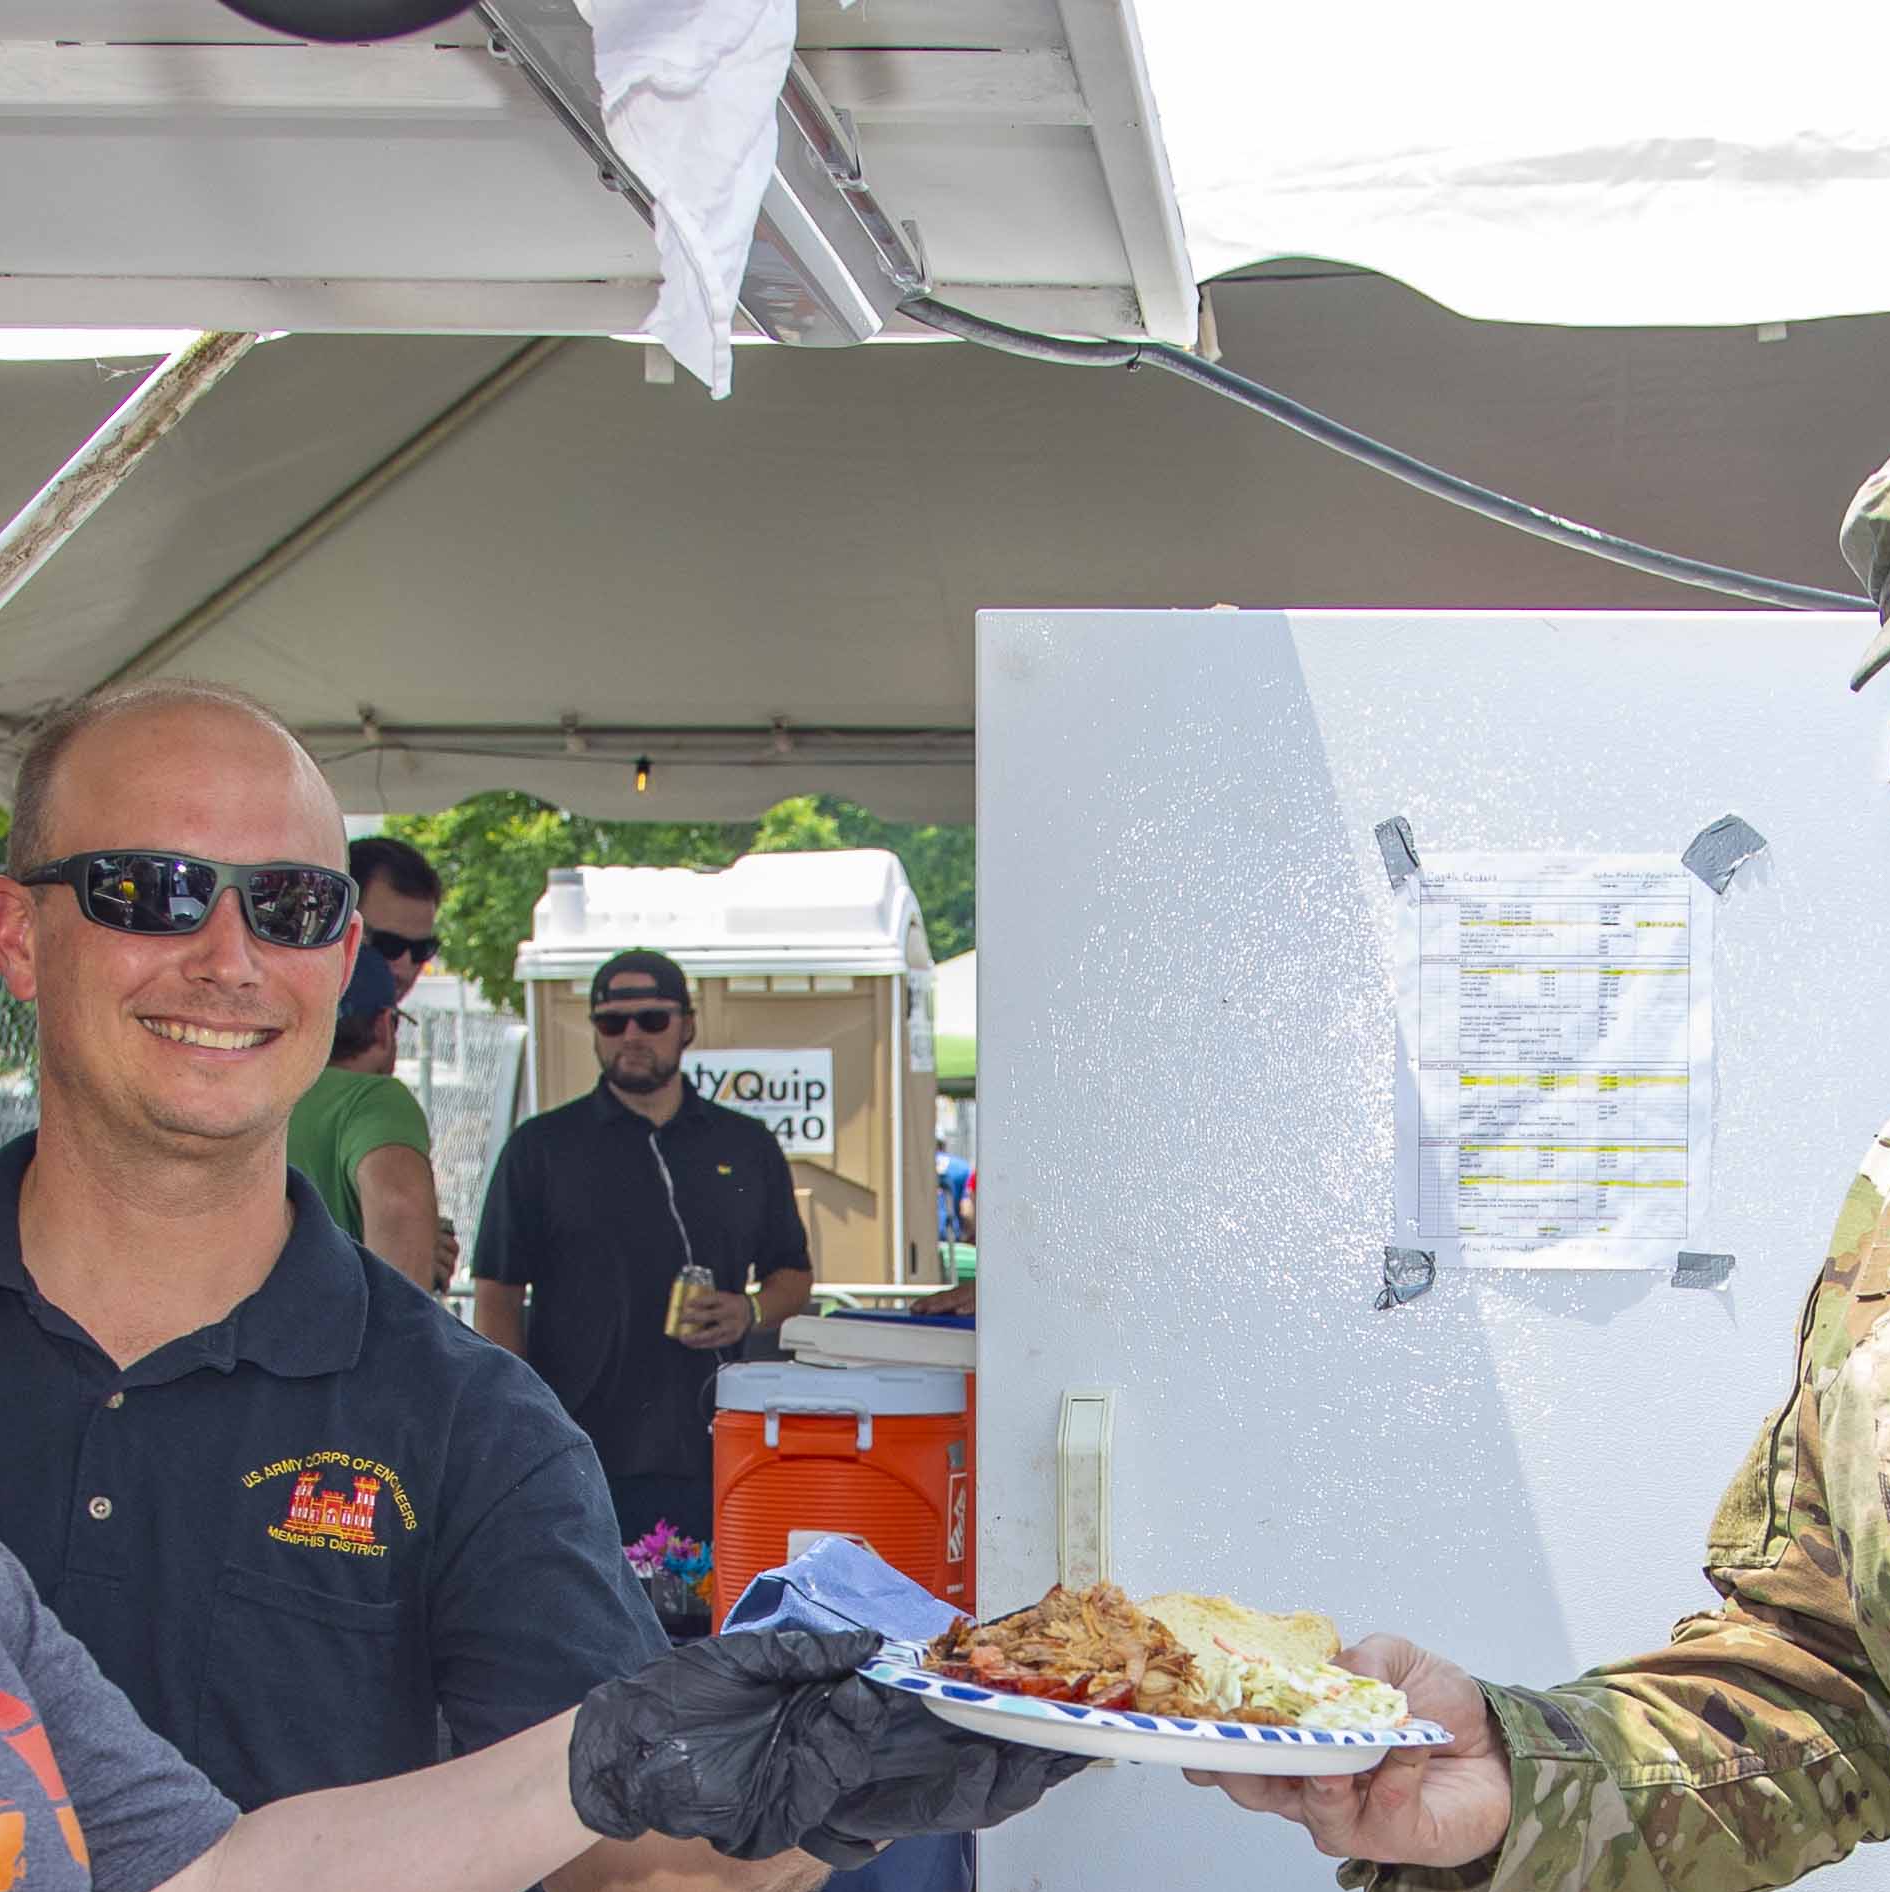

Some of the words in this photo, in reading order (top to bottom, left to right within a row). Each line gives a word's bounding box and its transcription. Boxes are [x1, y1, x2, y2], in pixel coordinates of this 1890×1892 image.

[263, 1458, 303, 1481] ARMY
[305, 1450, 350, 1468] CORPS
[352, 1457, 375, 1471] OF
[268, 1524, 325, 1548] MEMPHIS
[329, 1539, 388, 1558] DISTRICT
